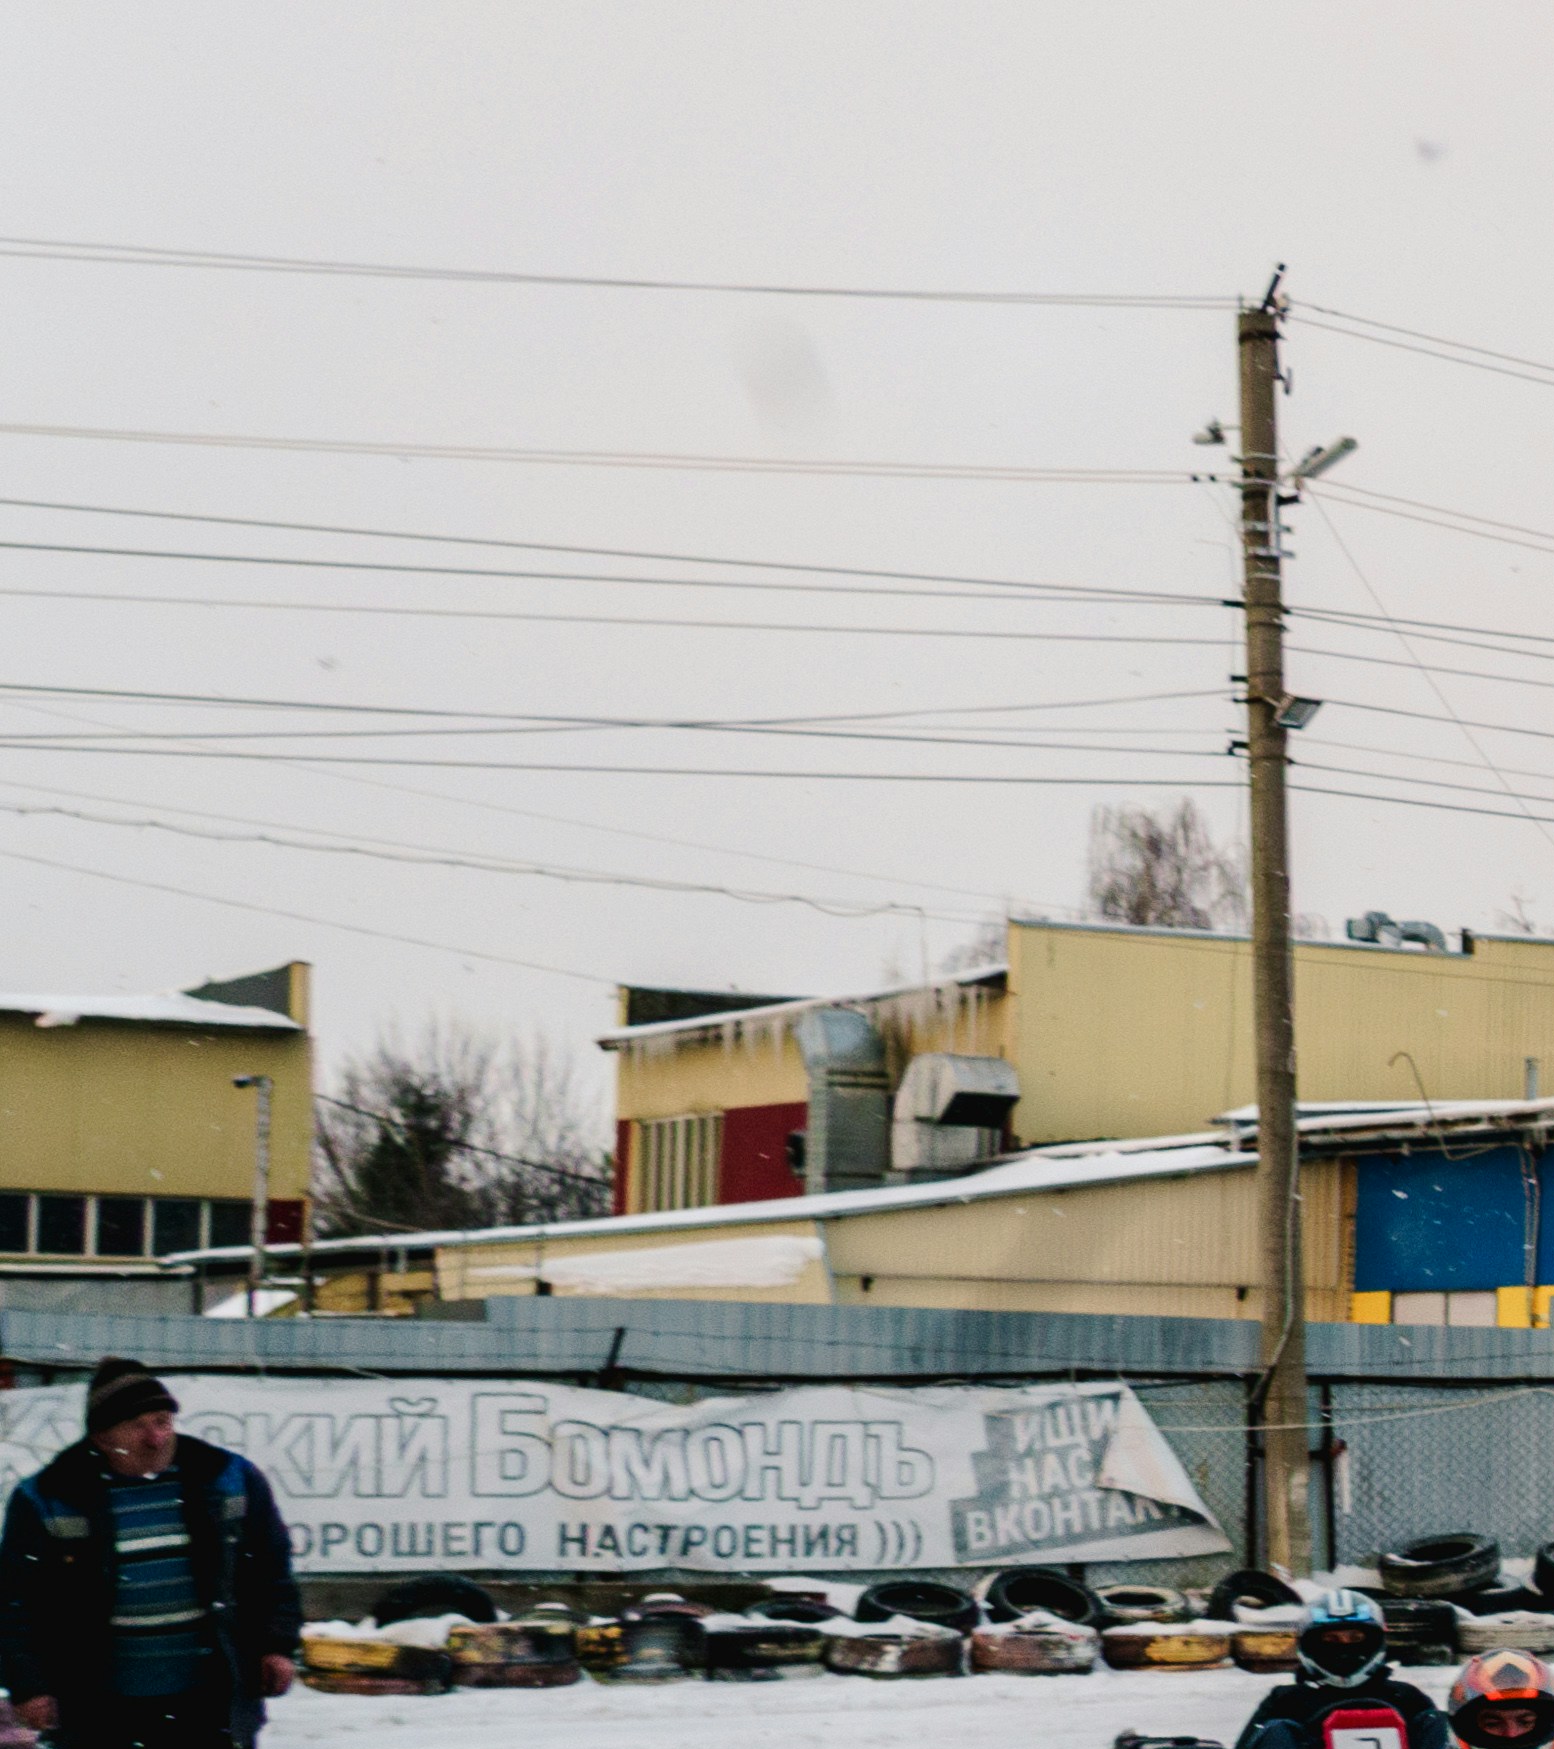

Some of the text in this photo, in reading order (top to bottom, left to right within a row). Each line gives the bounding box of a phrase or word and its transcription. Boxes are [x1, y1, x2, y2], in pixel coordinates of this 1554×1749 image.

[1006, 1447, 1095, 1500] НАС
[289, 1519, 526, 1558] ОРОШЕГО
[559, 1521, 859, 1558] НАСТРОЕНИЯ
